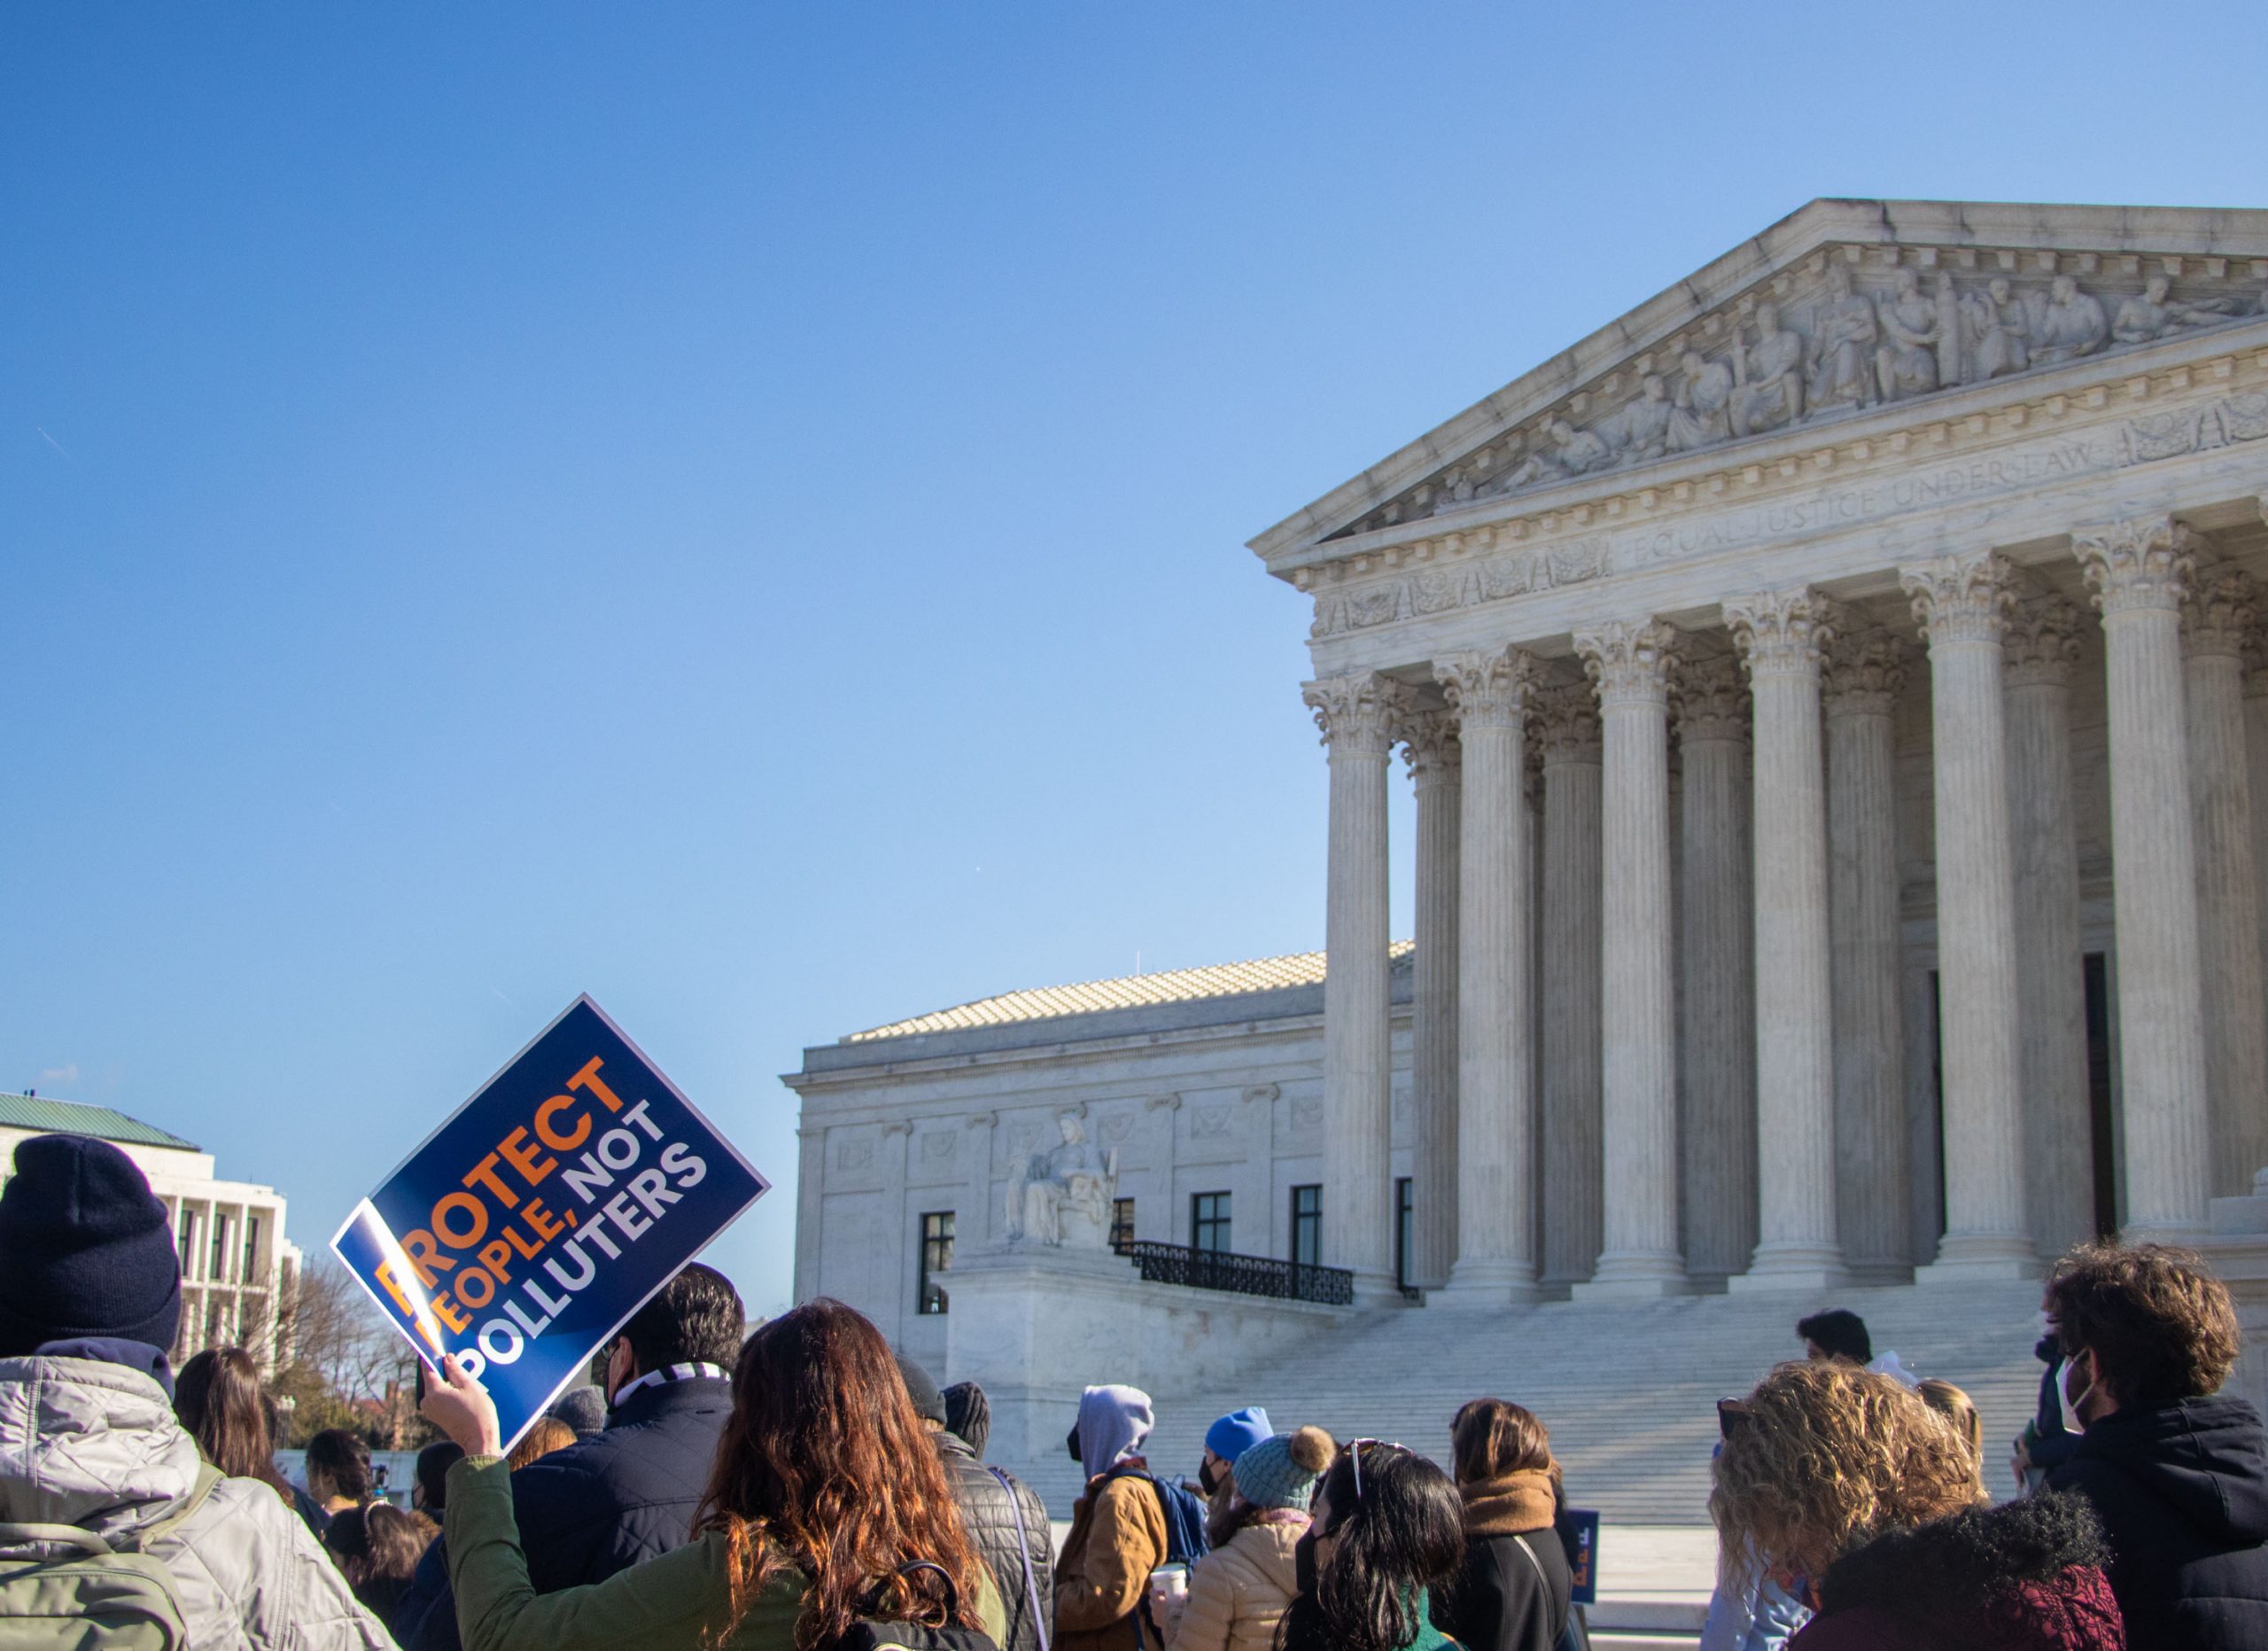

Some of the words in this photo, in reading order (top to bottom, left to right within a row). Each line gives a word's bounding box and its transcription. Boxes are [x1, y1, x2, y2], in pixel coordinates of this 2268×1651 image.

[1635, 518, 1738, 564] EQUAL
[1749, 493, 1876, 537] JUSTICE
[1893, 460, 2017, 506] UNDER
[2023, 442, 2093, 479] LAW
[561, 1099, 664, 1204] NOT
[454, 1142, 706, 1392] POLLUTERS
